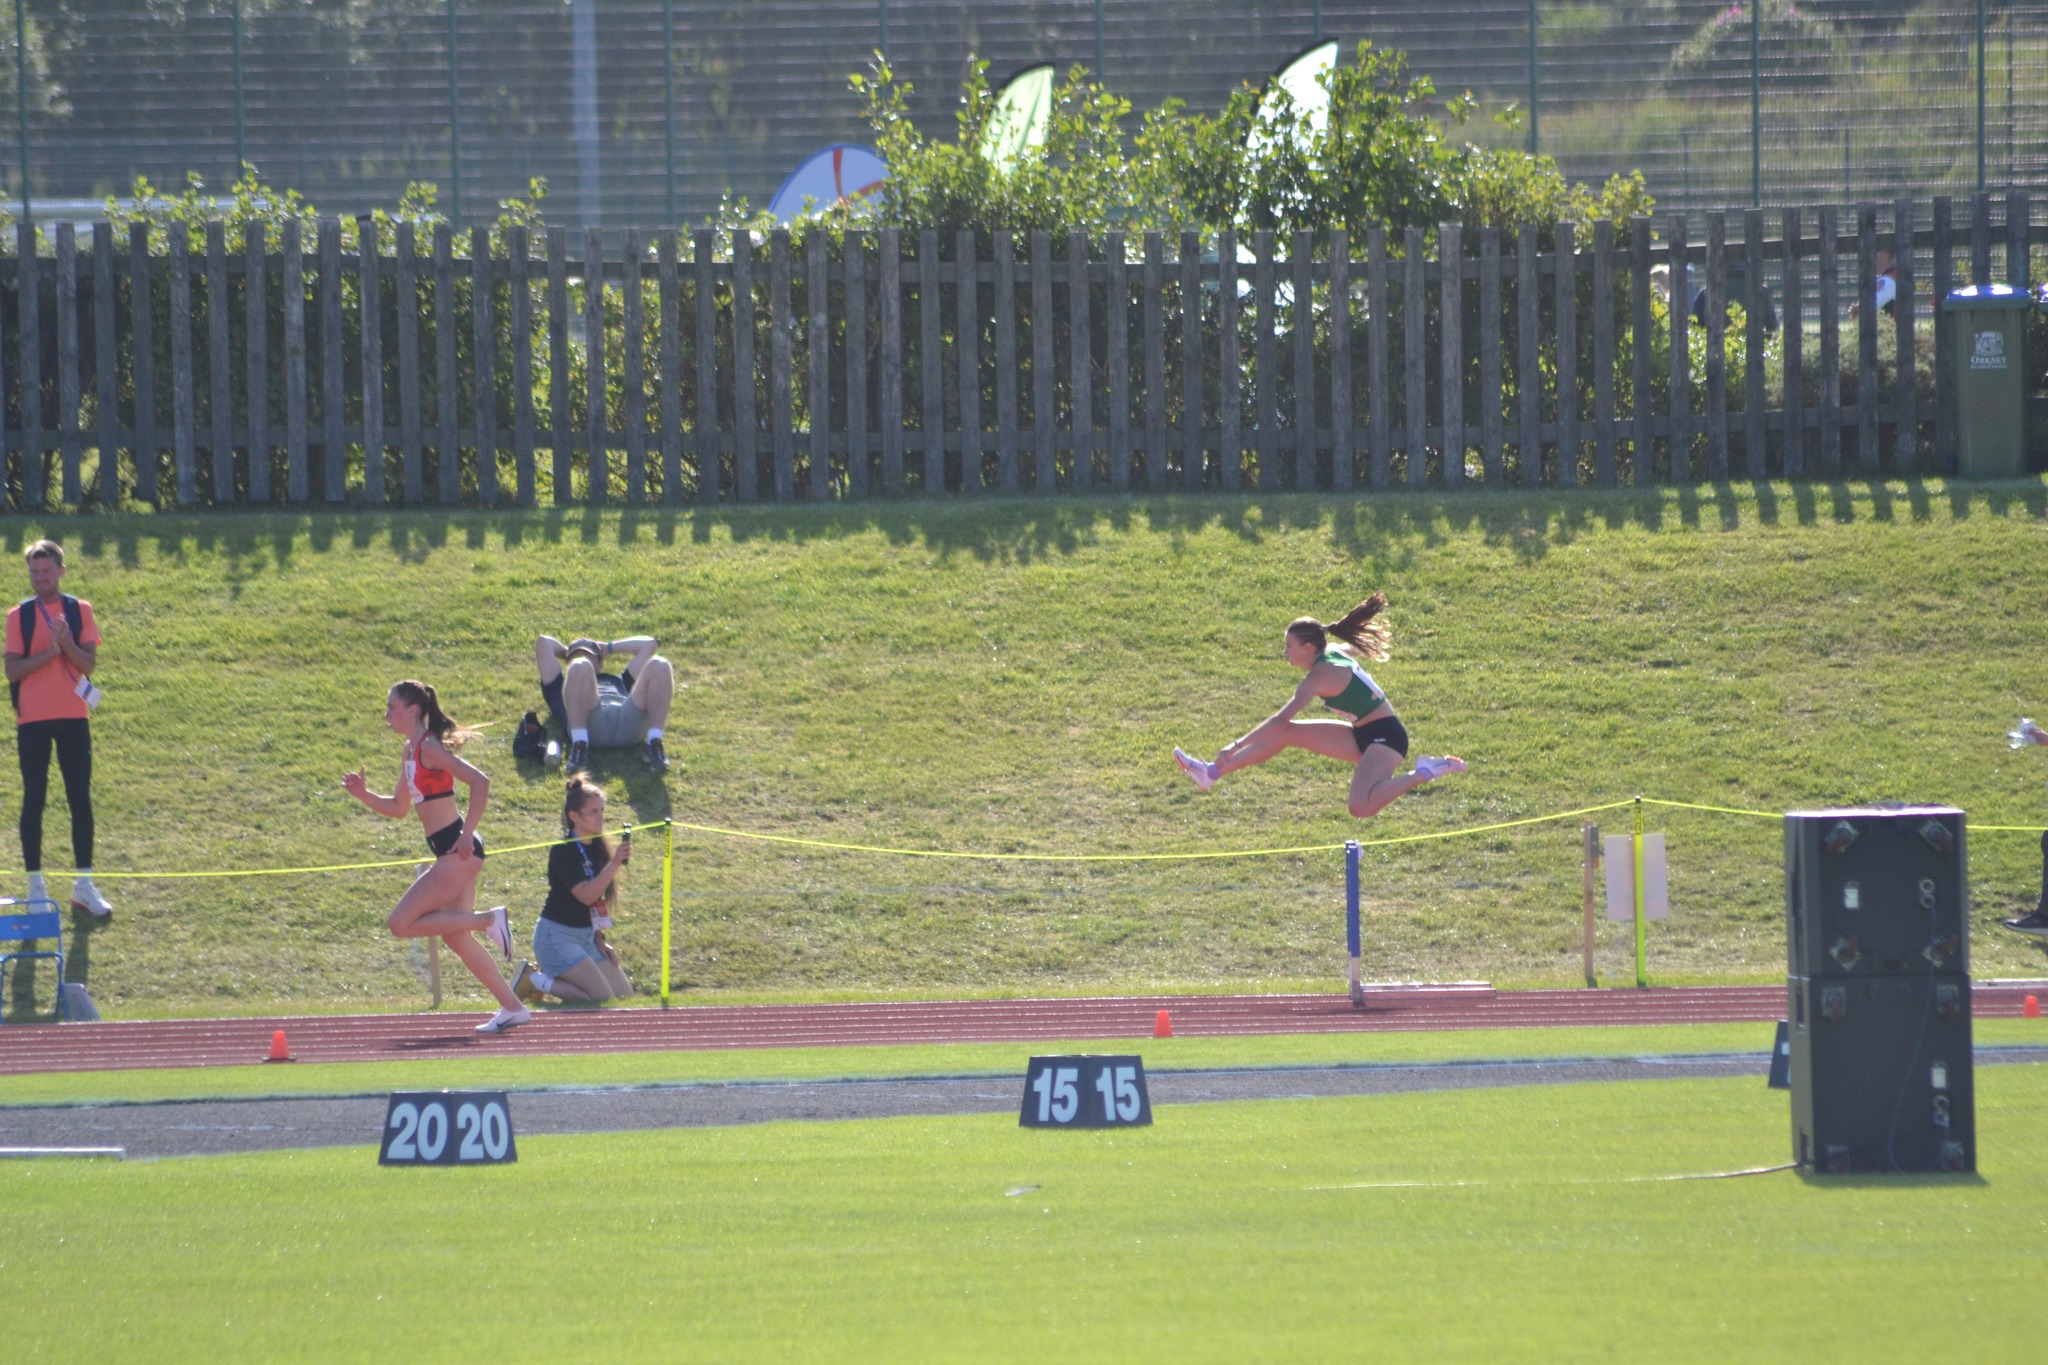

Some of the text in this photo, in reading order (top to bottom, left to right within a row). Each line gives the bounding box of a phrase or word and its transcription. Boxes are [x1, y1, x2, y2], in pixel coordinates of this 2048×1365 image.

[1033, 1067, 1079, 1123] 15
[1096, 1066, 1141, 1122] 15
[386, 1102, 448, 1161] 20
[456, 1102, 509, 1160] 20
